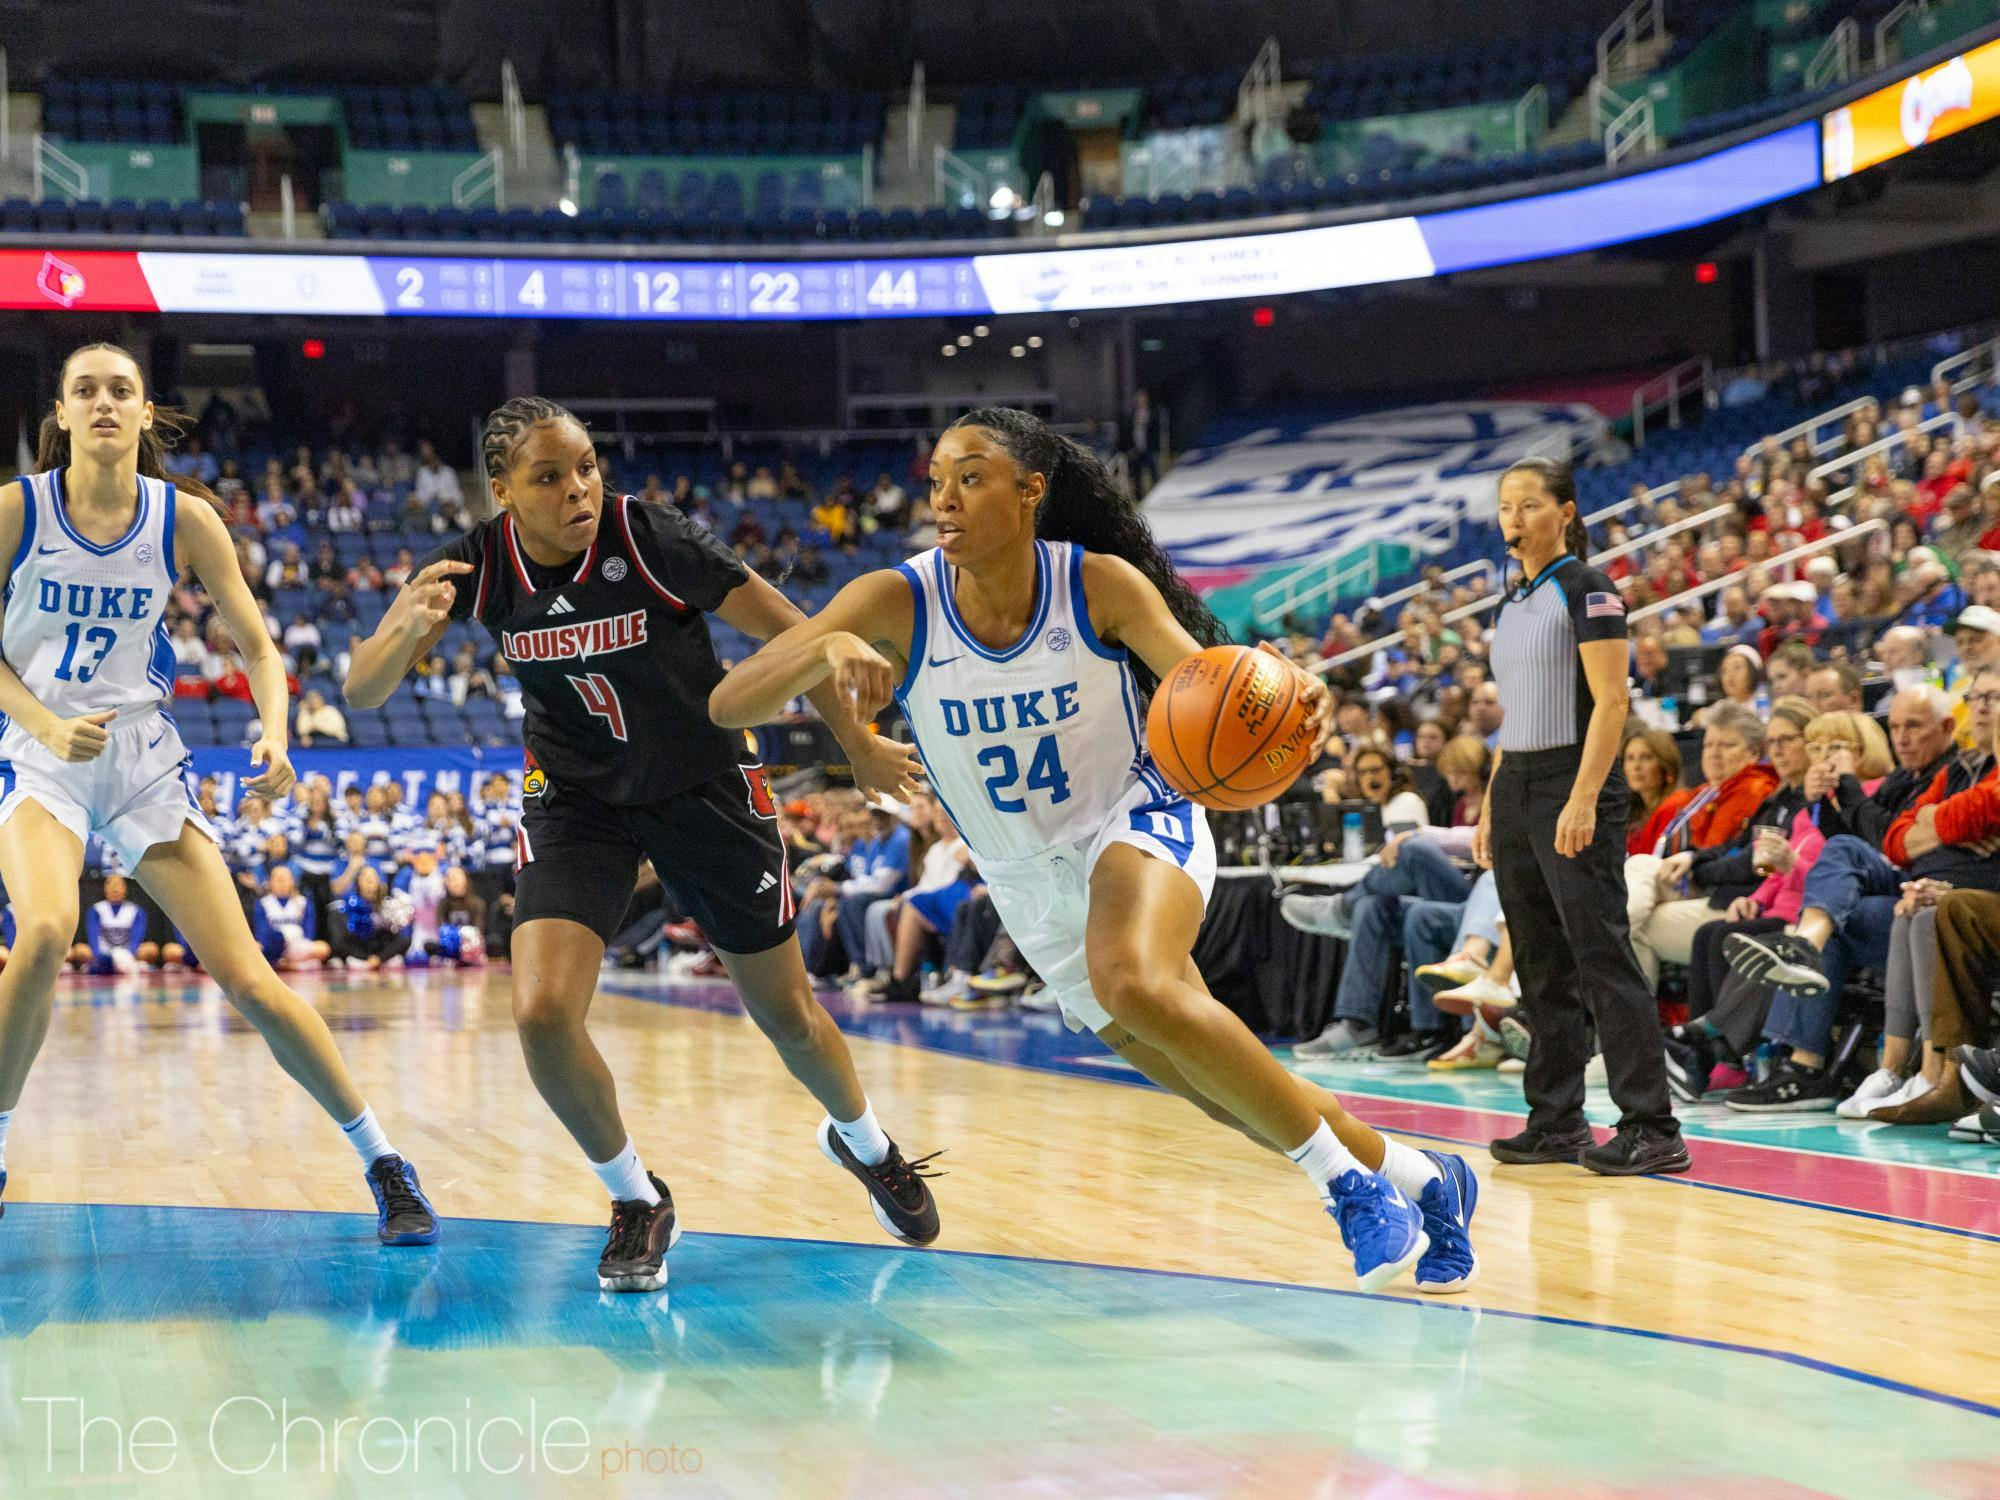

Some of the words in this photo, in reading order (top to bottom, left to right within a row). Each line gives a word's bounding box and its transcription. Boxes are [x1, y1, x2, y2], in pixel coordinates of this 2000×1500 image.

[396, 267, 425, 308] 2
[517, 270, 547, 310] 4
[632, 271, 681, 312] 12
[749, 271, 801, 312] 22
[867, 269, 919, 309] 44
[39, 578, 152, 619] DUKE
[54, 622, 117, 683] 13
[502, 608, 647, 662] LOUISVILLE
[565, 672, 628, 742] 4
[939, 681, 1080, 736] DUKE
[976, 733, 1071, 813] 24
